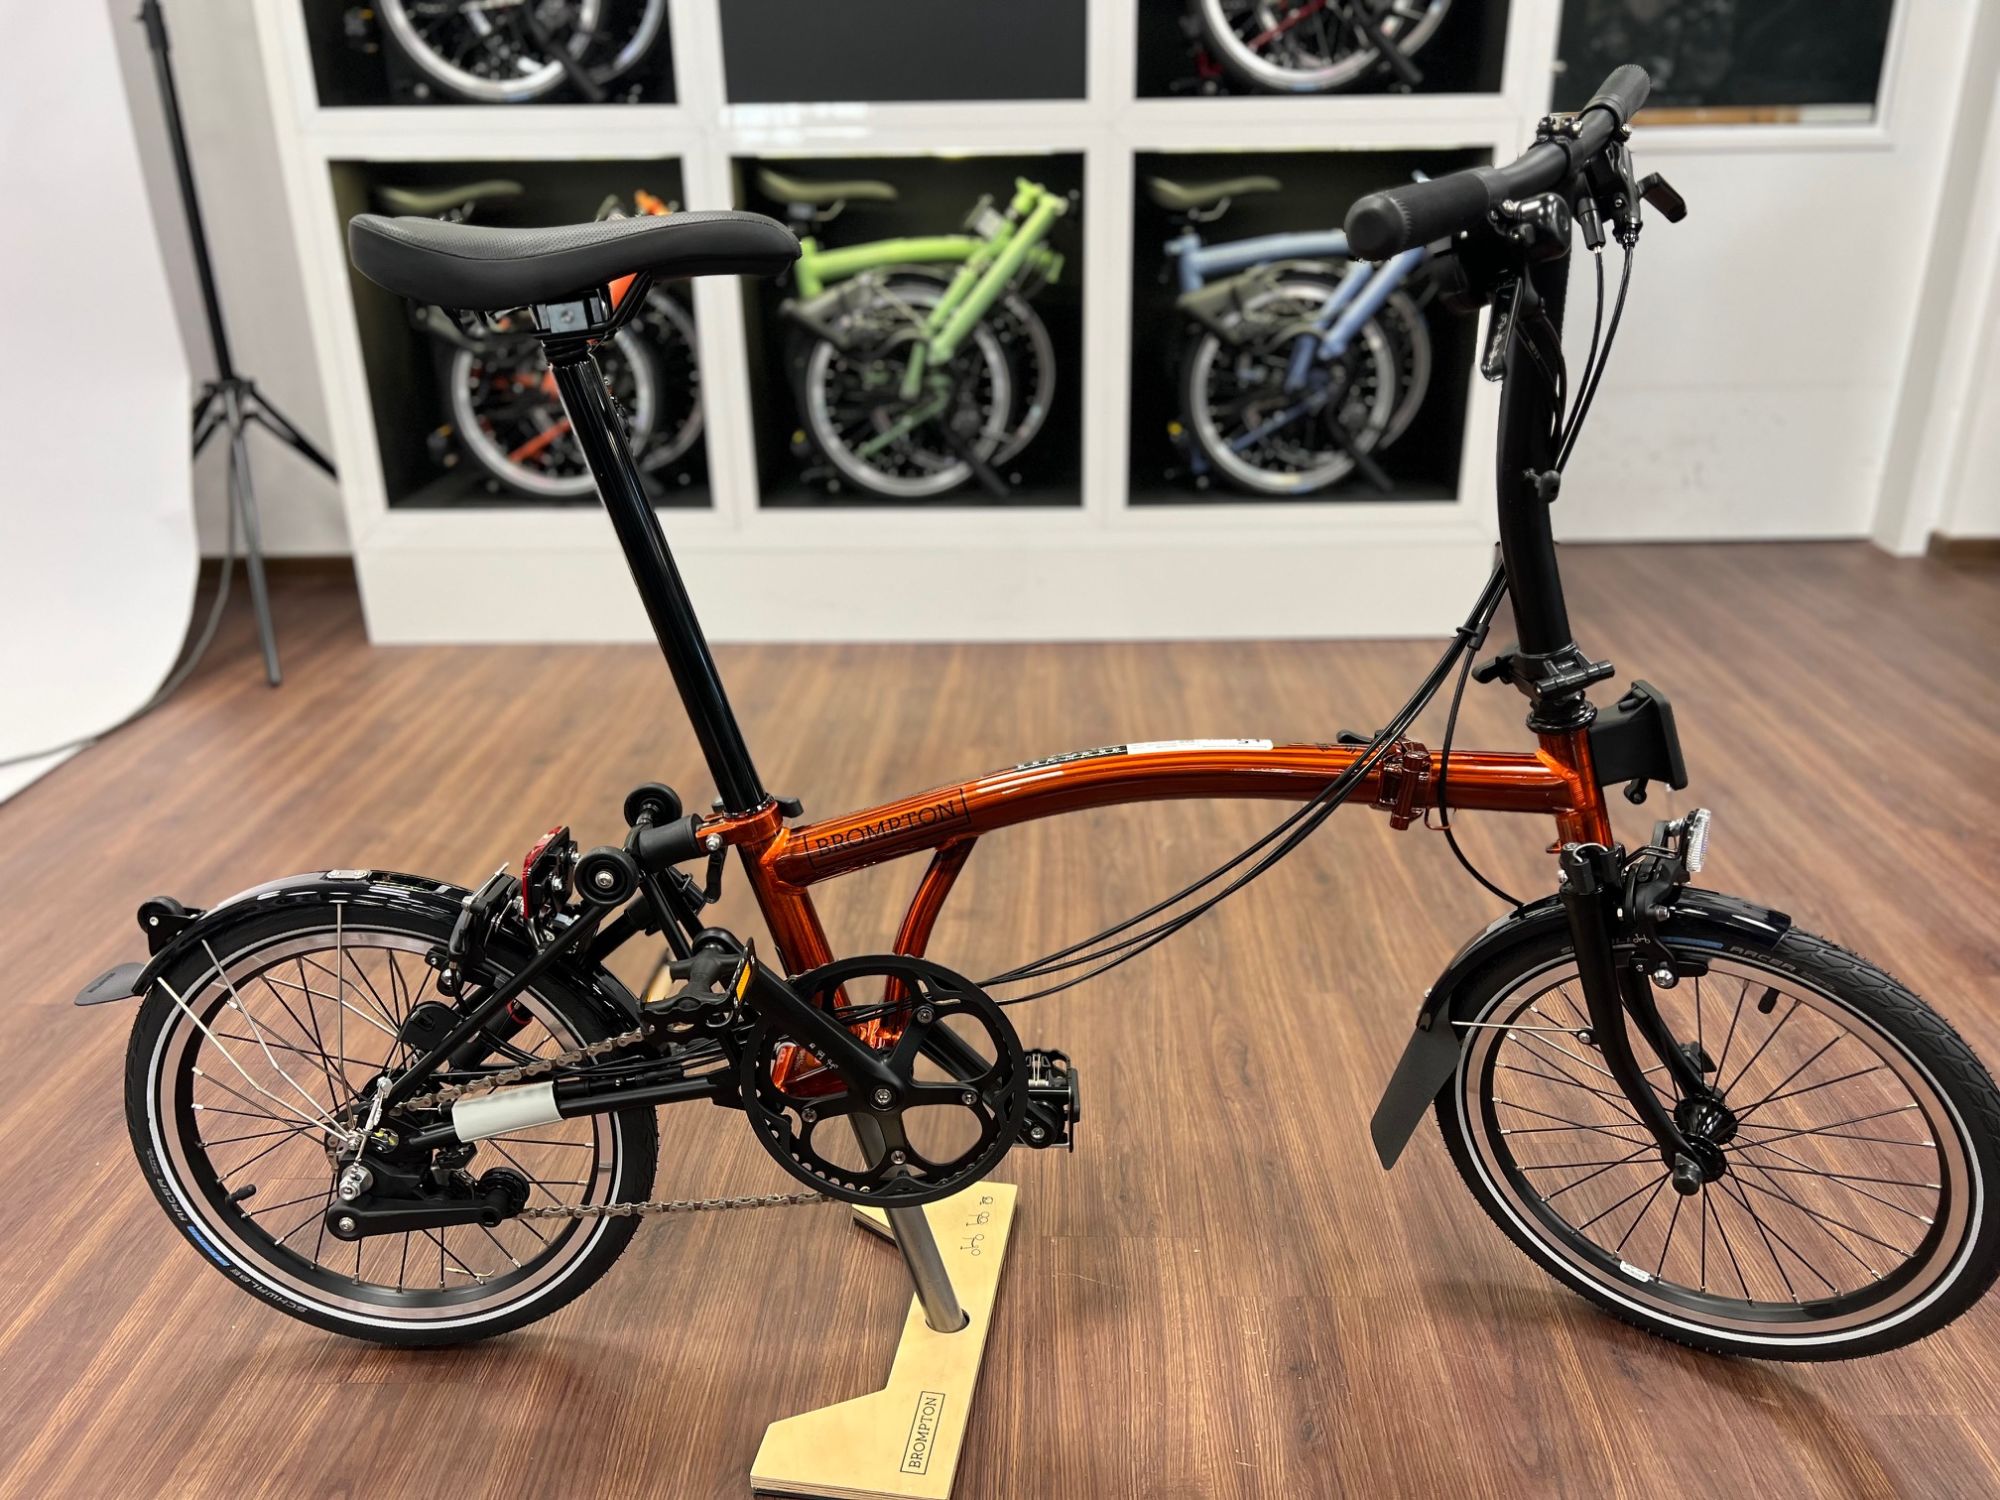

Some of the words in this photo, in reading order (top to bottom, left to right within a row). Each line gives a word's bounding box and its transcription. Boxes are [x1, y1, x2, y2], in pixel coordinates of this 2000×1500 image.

[815, 800, 957, 857] BROMPTON
[1729, 945, 1797, 972] RACER
[229, 1268, 308, 1313] SCHWALBE
[908, 1396, 937, 1469] BROMPTON
